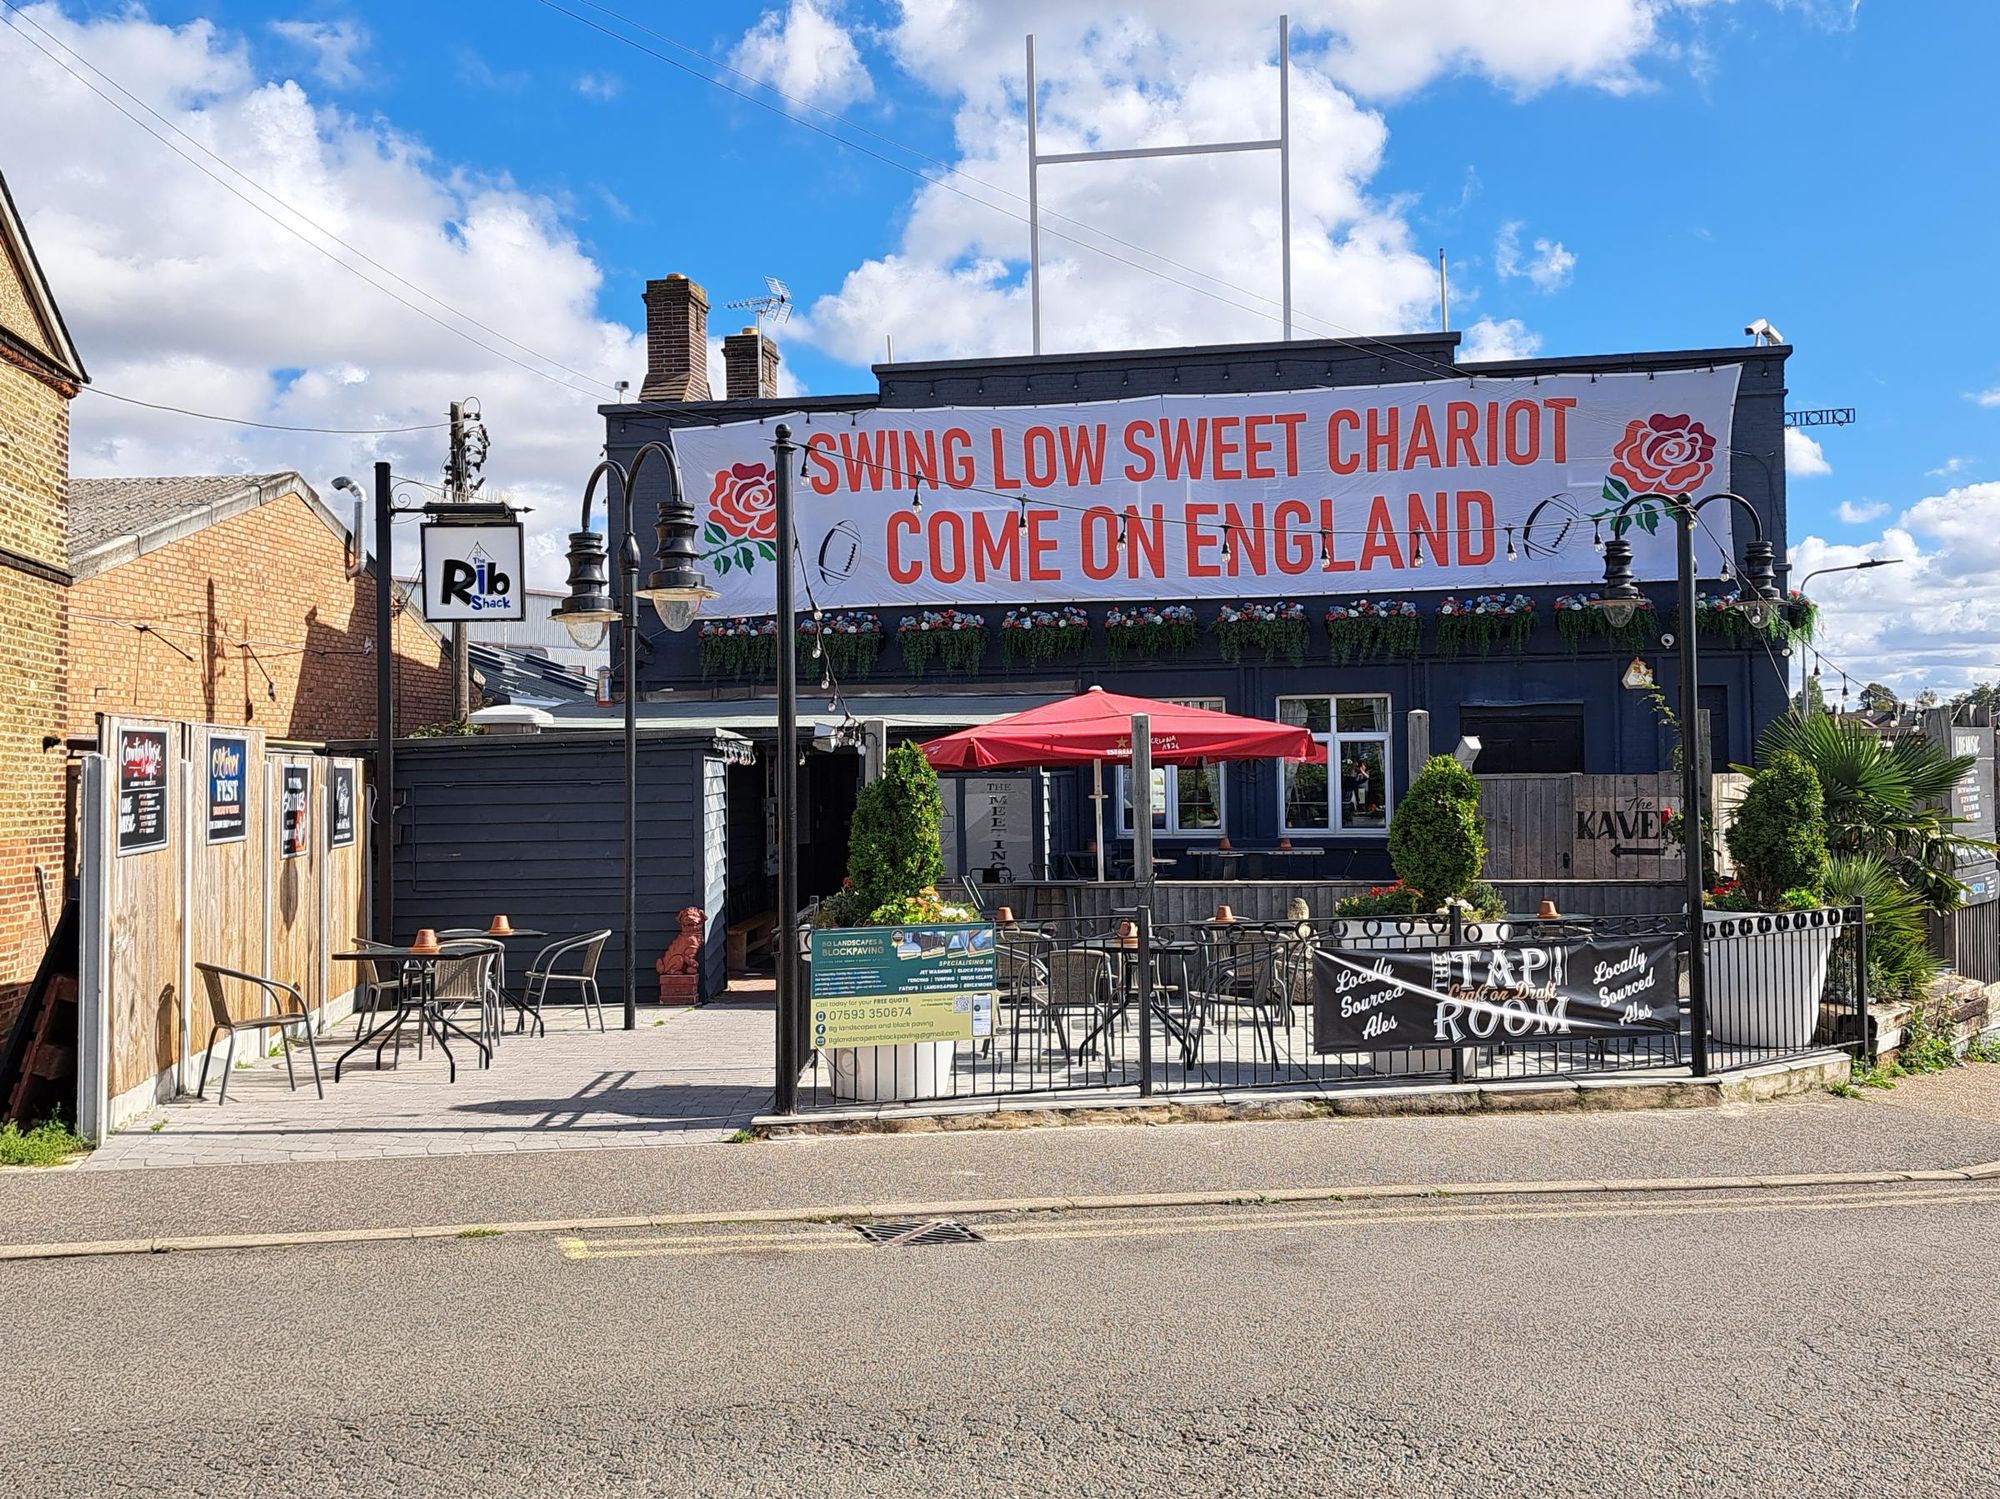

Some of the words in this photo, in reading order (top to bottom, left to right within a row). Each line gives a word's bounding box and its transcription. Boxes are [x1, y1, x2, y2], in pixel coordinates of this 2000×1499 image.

[807, 426, 976, 496] SWING
[992, 422, 1108, 490] LOW
[1124, 412, 1307, 482] SWEET
[1327, 397, 1577, 476] CHARIOT
[886, 508, 1062, 585] COME
[1080, 504, 1165, 581] ON
[1185, 490, 1495, 578] ENGLAND
[472, 557, 485, 565] The
[441, 559, 510, 605] Rib
[471, 595, 511, 610] Shack
[1151, 735, 1177, 745] CELONA
[216, 779, 239, 802] FEST
[987, 783, 1012, 791] THE
[1625, 797, 1655, 811] The
[1576, 810, 1672, 839] KAVE
[822, 946, 884, 956] BLOCKPAVING
[833, 939, 877, 947] LANDSCAPES
[938, 959, 984, 967] SPECIALISING
[1335, 957, 1394, 993] Locally
[1433, 952, 1449, 991] THE
[1450, 947, 1549, 990] TAP
[1593, 946, 1647, 984] Locally
[1447, 983, 1488, 1002] Craft
[1490, 990, 1510, 1001] on
[1512, 980, 1558, 1002] Draft
[1599, 967, 1655, 1007] Sourced
[829, 1009, 865, 1021] 07593
[868, 1006, 912, 1019] 350674
[1340, 986, 1405, 1018] Sourced
[1618, 1001, 1652, 1026] Ales
[839, 1023, 877, 1031] landscapes
[912, 1021, 934, 1029] paving
[1362, 1012, 1398, 1040] Ales
[1433, 996, 1571, 1044] ROOM
